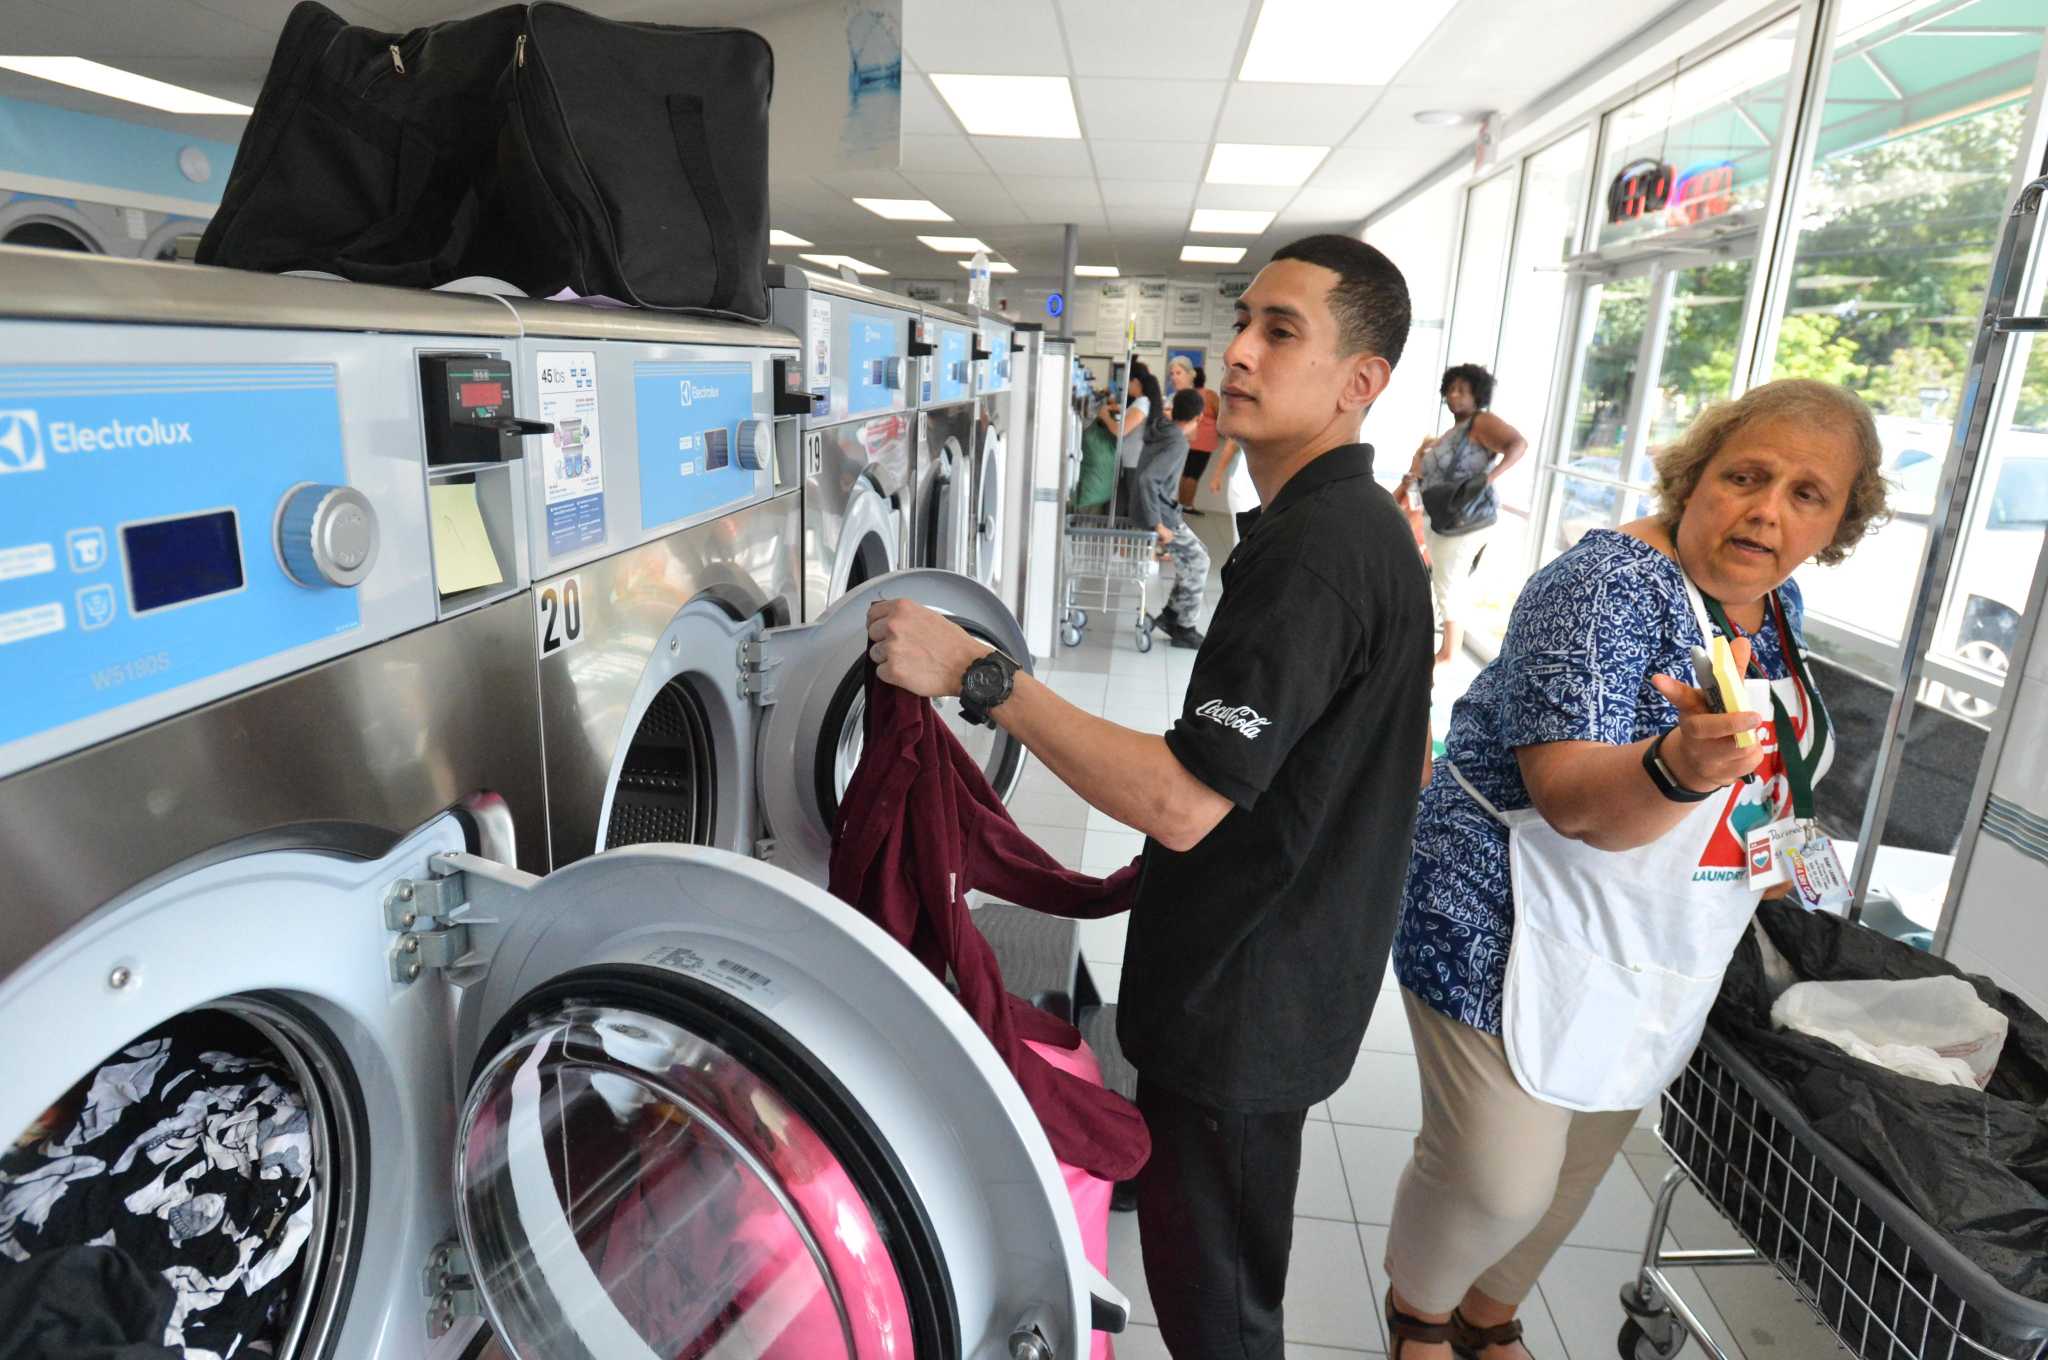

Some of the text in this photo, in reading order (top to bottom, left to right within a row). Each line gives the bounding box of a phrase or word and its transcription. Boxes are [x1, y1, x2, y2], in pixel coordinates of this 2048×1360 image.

[541, 368, 553, 384] 45
[50, 416, 192, 453] Electrolux
[808, 435, 820, 473] 19
[541, 579, 580, 654] 20
